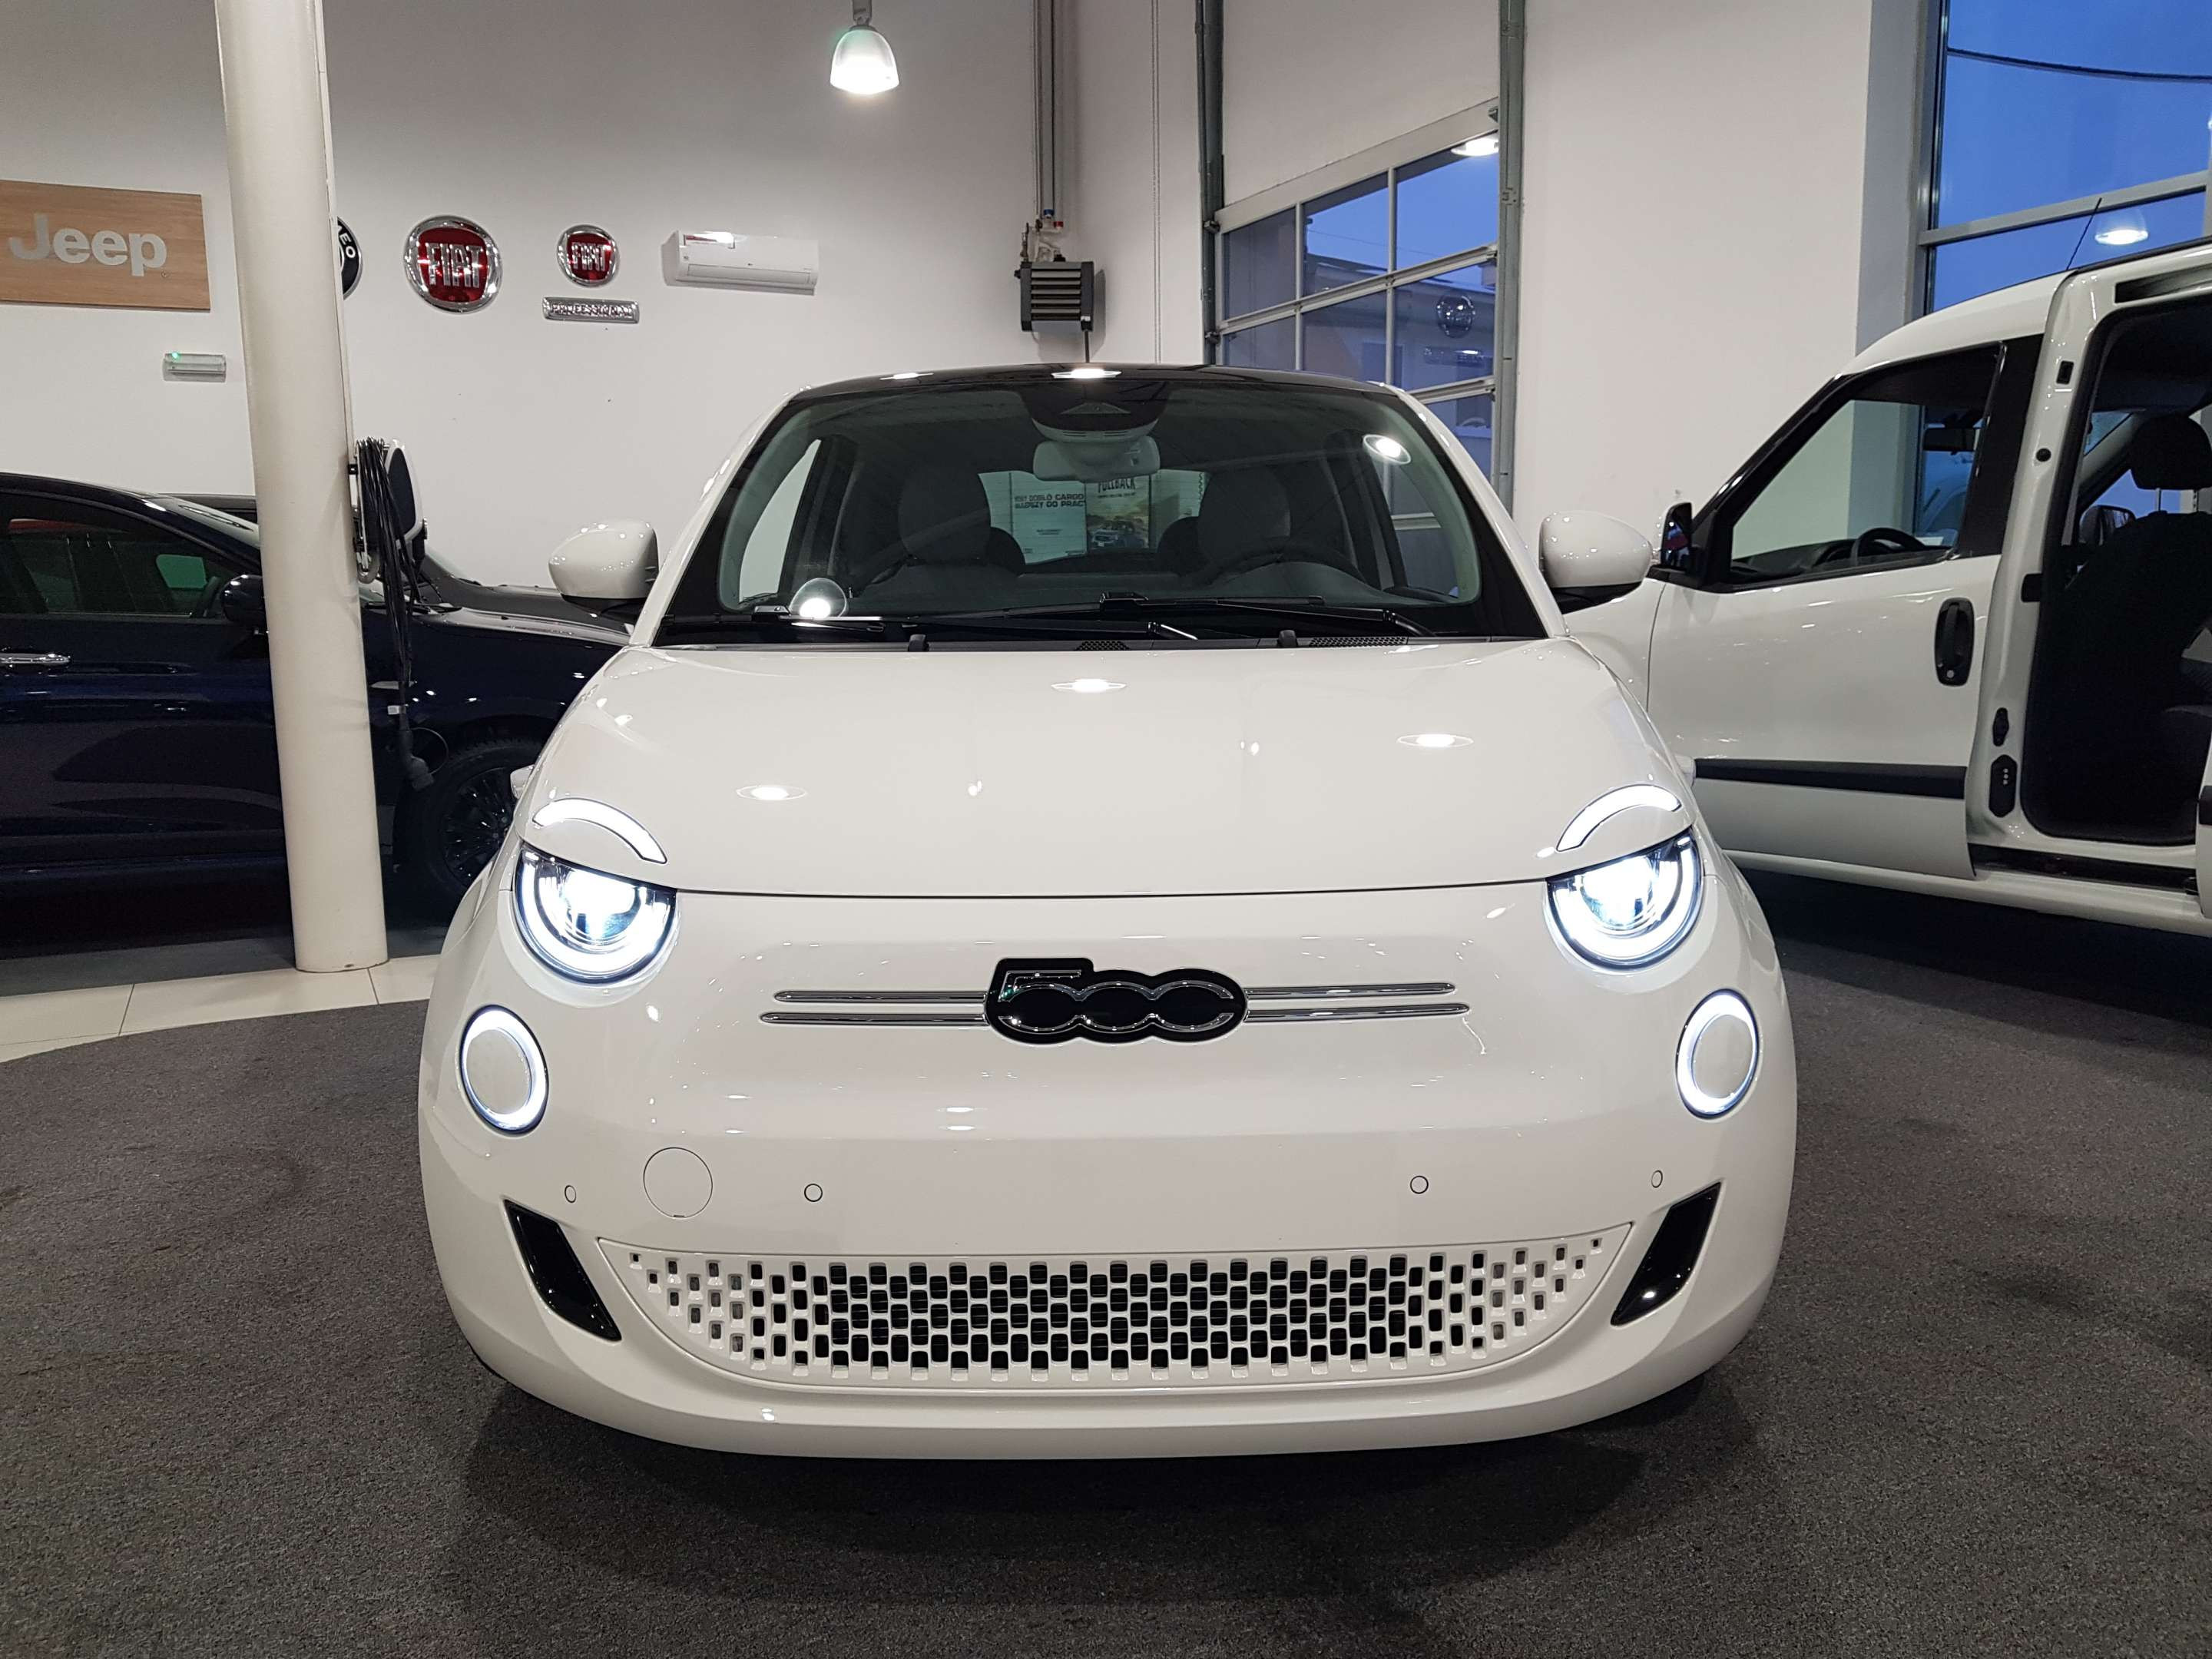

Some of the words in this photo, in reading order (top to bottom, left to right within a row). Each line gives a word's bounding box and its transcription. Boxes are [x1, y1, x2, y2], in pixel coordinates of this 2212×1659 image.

[8, 213, 167, 276] Jeep
[426, 243, 483, 288] FIAT
[571, 241, 608, 271] FIAT
[998, 970, 1233, 1035] 500
